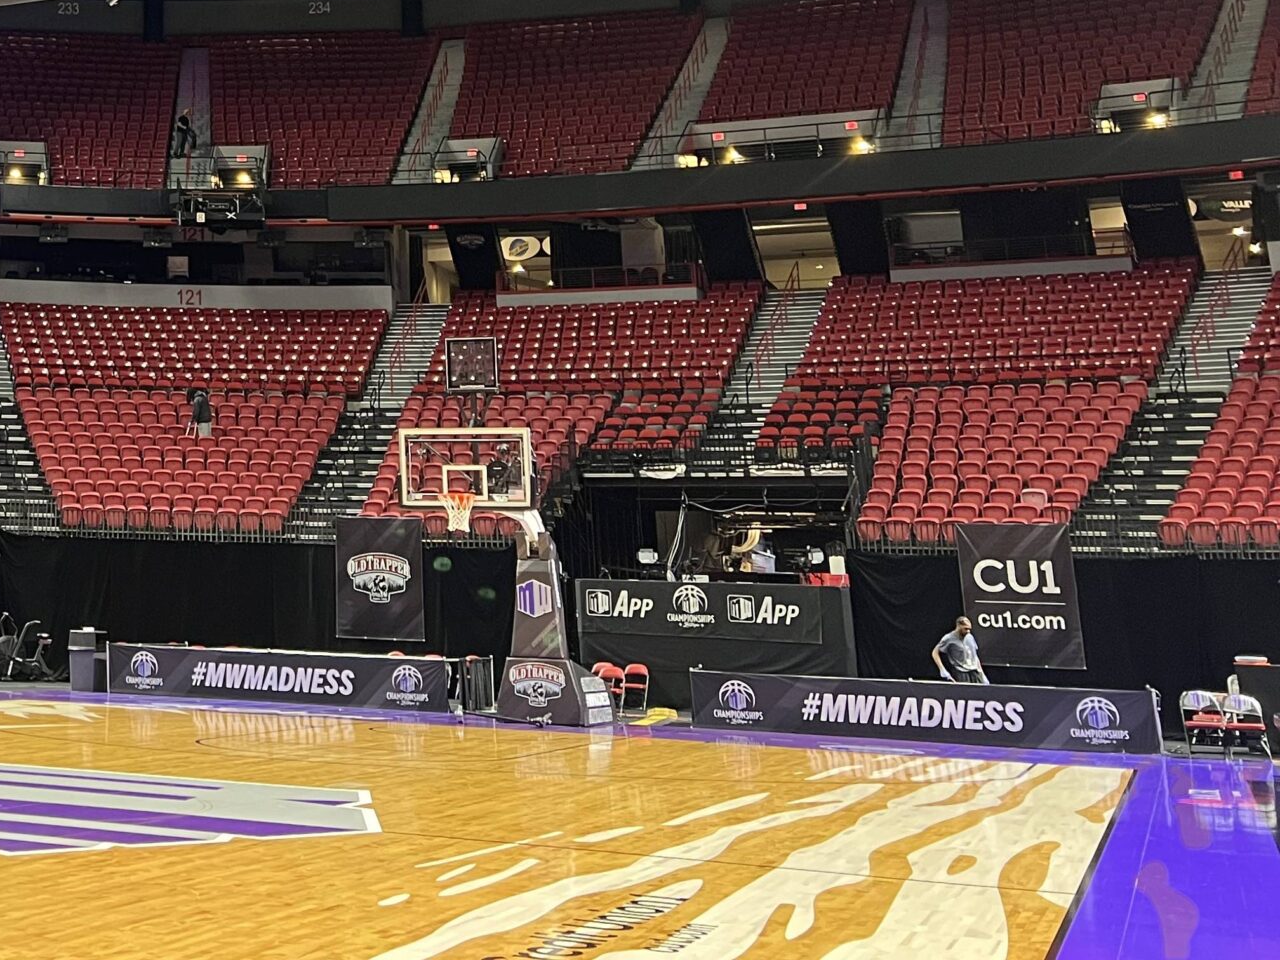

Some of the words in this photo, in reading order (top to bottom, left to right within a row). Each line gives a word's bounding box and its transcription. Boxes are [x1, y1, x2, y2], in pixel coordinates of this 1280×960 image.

[58, 2, 80, 15] 233
[309, 1, 331, 15] 234
[177, 288, 202, 306] 121
[347, 558, 367, 575] OLD
[366, 556, 411, 579] TRAPPER
[973, 559, 1061, 594] CU1
[667, 613, 715, 624] CHAMPIONSHIPS
[977, 611, 1066, 630] cu1.com
[191, 661, 356, 696] #MWMADNESS
[713, 708, 764, 721] CHAMPIONSHIPS
[801, 692, 1025, 733] #MWMADNESS
[1070, 728, 1130, 741] CHAMPIONSHIPS
[481, 929, 618, 960] redit
